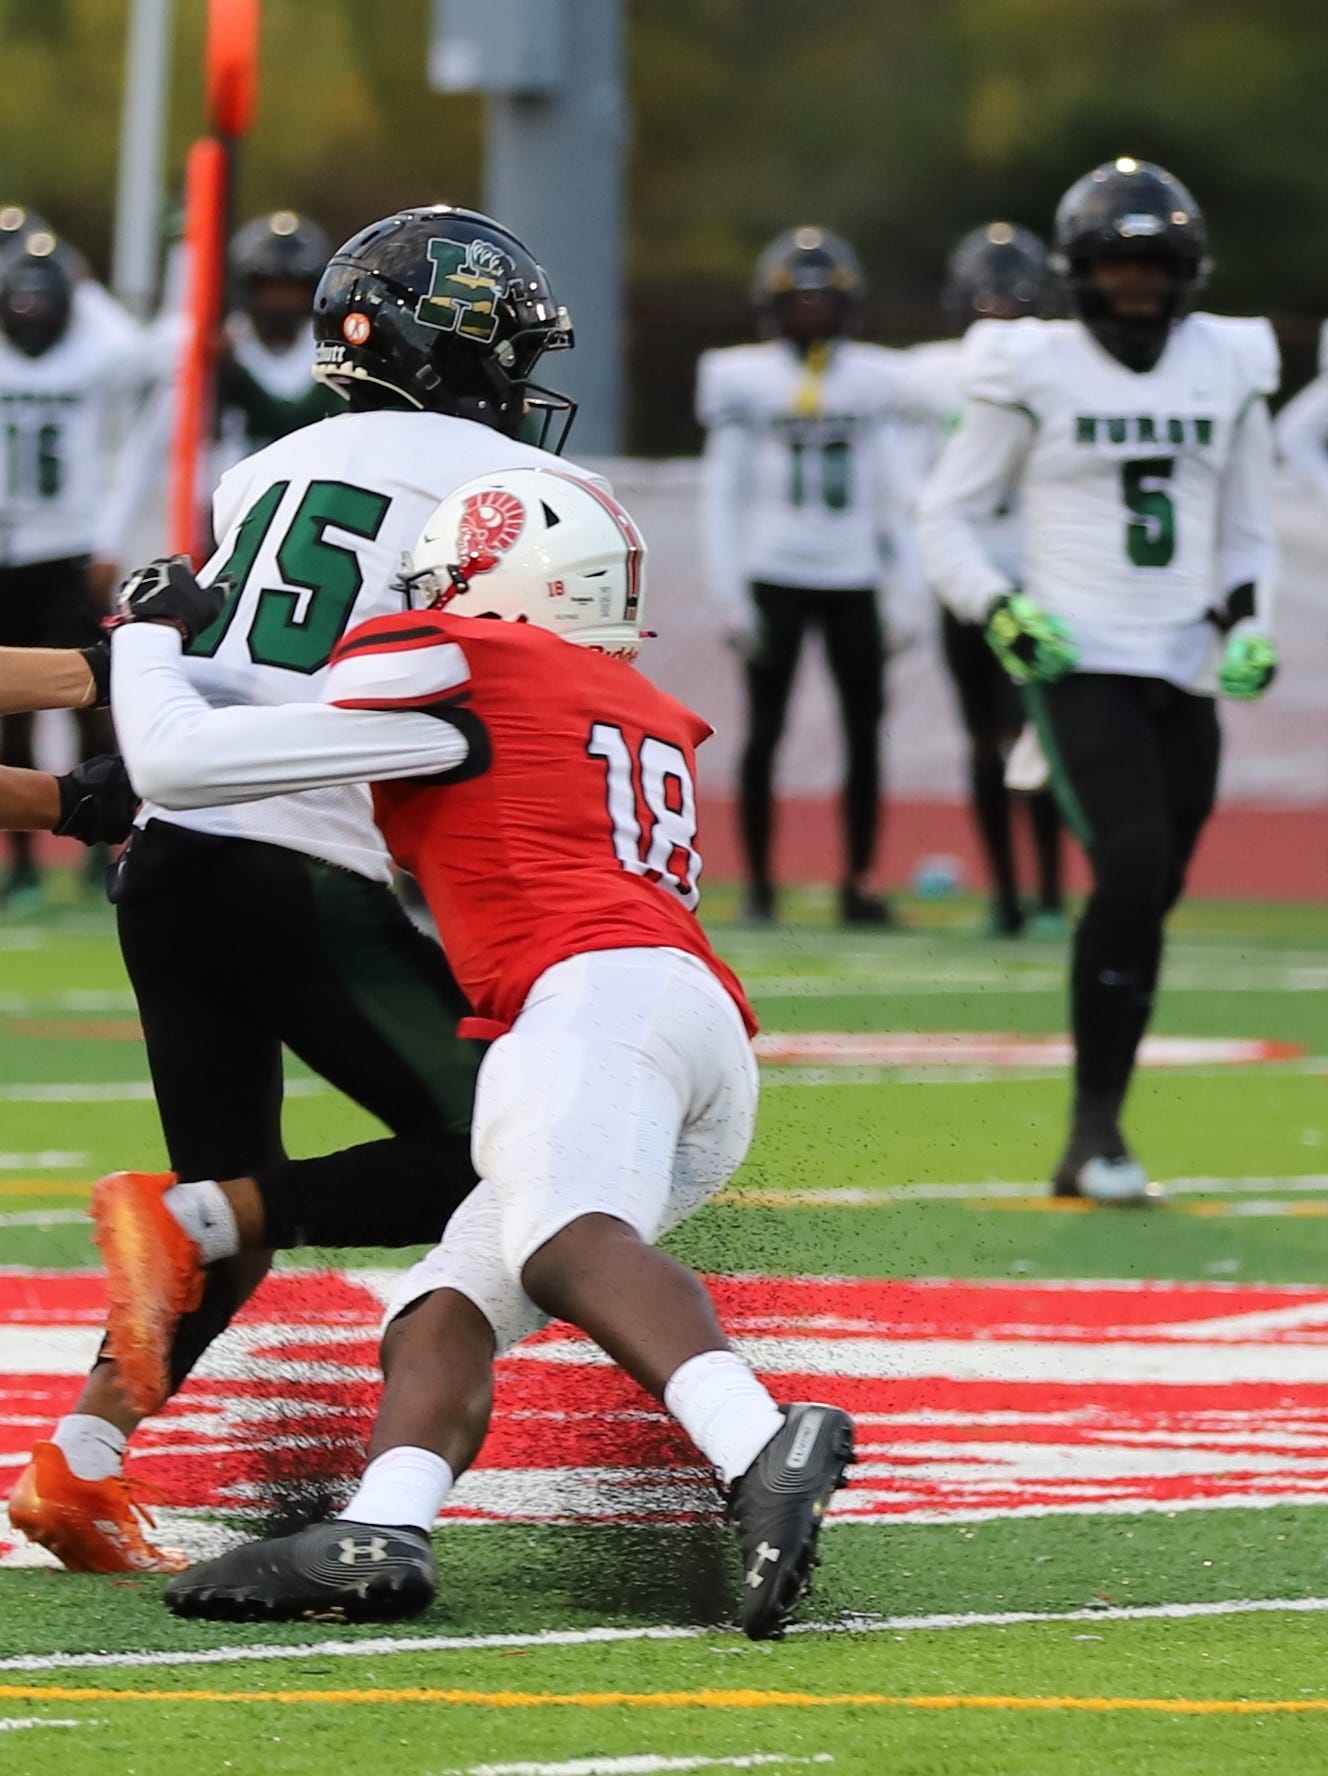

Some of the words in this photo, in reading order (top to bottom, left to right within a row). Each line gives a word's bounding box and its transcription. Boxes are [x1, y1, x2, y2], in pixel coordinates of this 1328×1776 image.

[1076, 417, 1214, 446] HURON
[181, 480, 393, 675] 15
[1121, 456, 1176, 567] 5
[586, 720, 703, 914] 18
